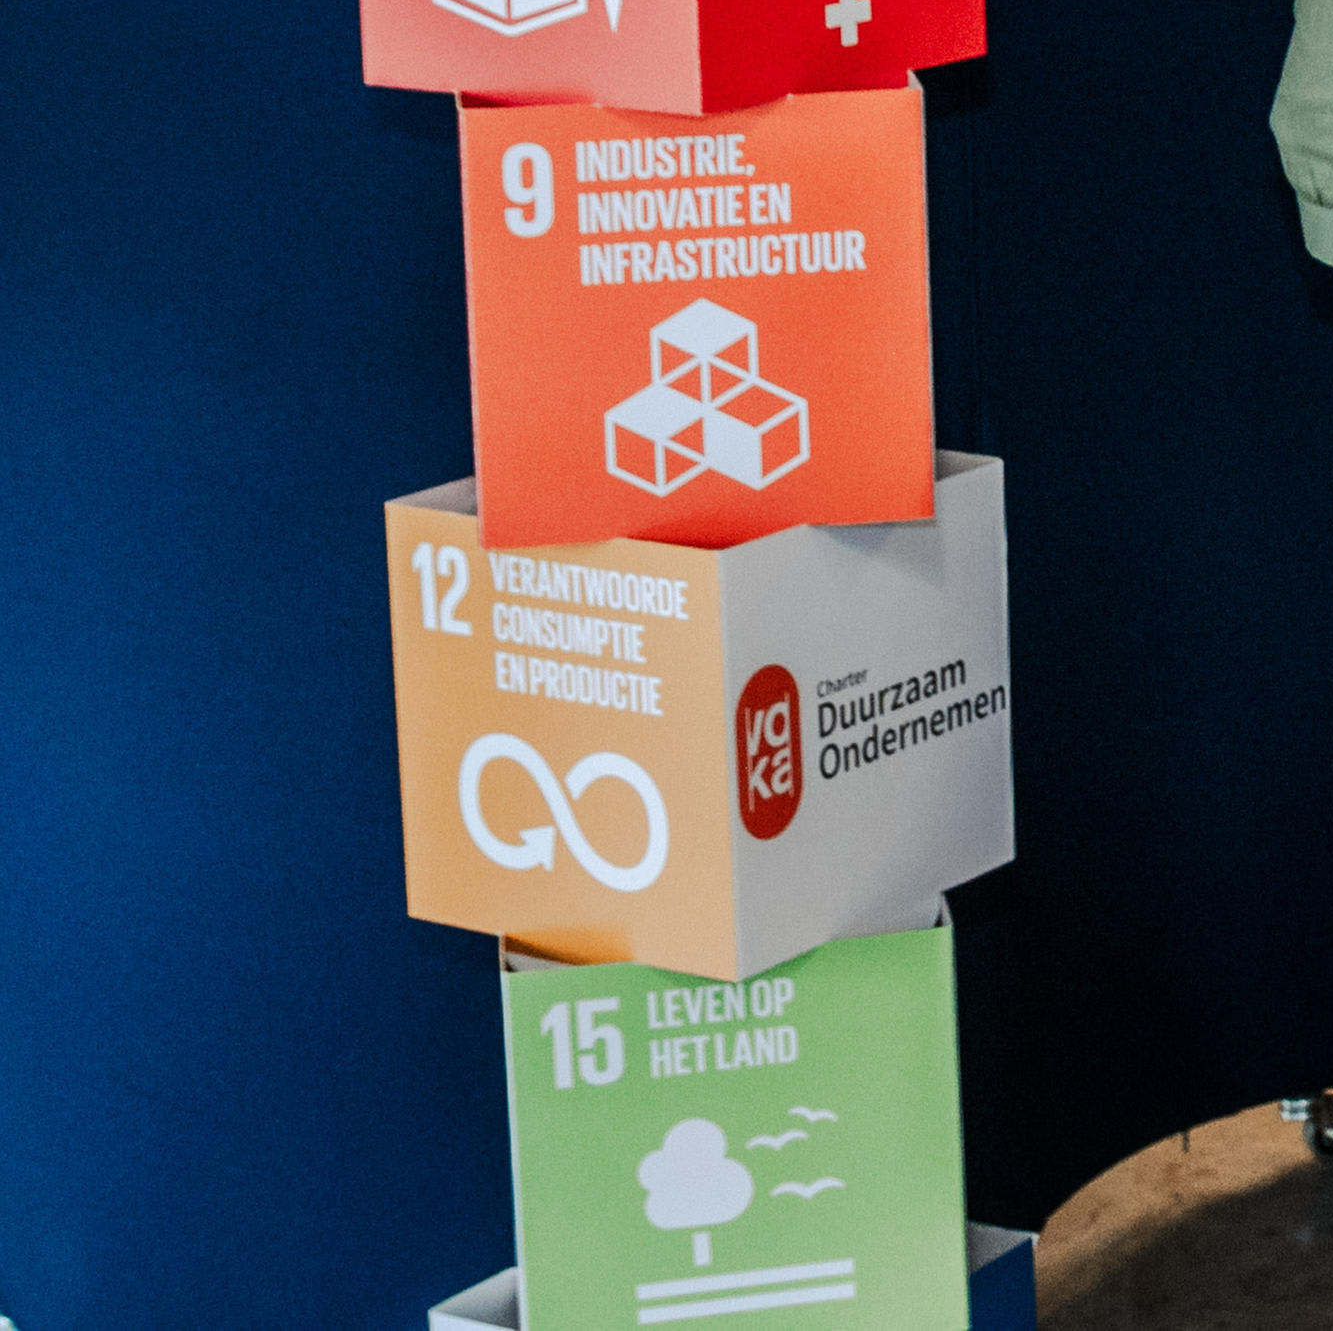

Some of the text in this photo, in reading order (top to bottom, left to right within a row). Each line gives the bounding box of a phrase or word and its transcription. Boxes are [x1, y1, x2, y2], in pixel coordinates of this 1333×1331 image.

[502, 142, 555, 237] 9
[575, 134, 756, 183] INDUSTRIE,
[577, 183, 791, 234] INNOVATIE EN
[579, 230, 867, 286] INFRASTRUCTUUR
[411, 542, 473, 636] 12
[488, 552, 689, 620] VERANTWOORDE
[492, 602, 647, 664] CONSUMPTIE
[494, 651, 664, 717] EN PRODUCTIE
[817, 669, 867, 698] Charter
[818, 659, 967, 738] Duurzaam
[820, 685, 1007, 780] Ondernemen
[647, 977, 795, 1030] LEVEN OP
[540, 996, 625, 1091] 15
[649, 1026, 798, 1078] HET LAND
